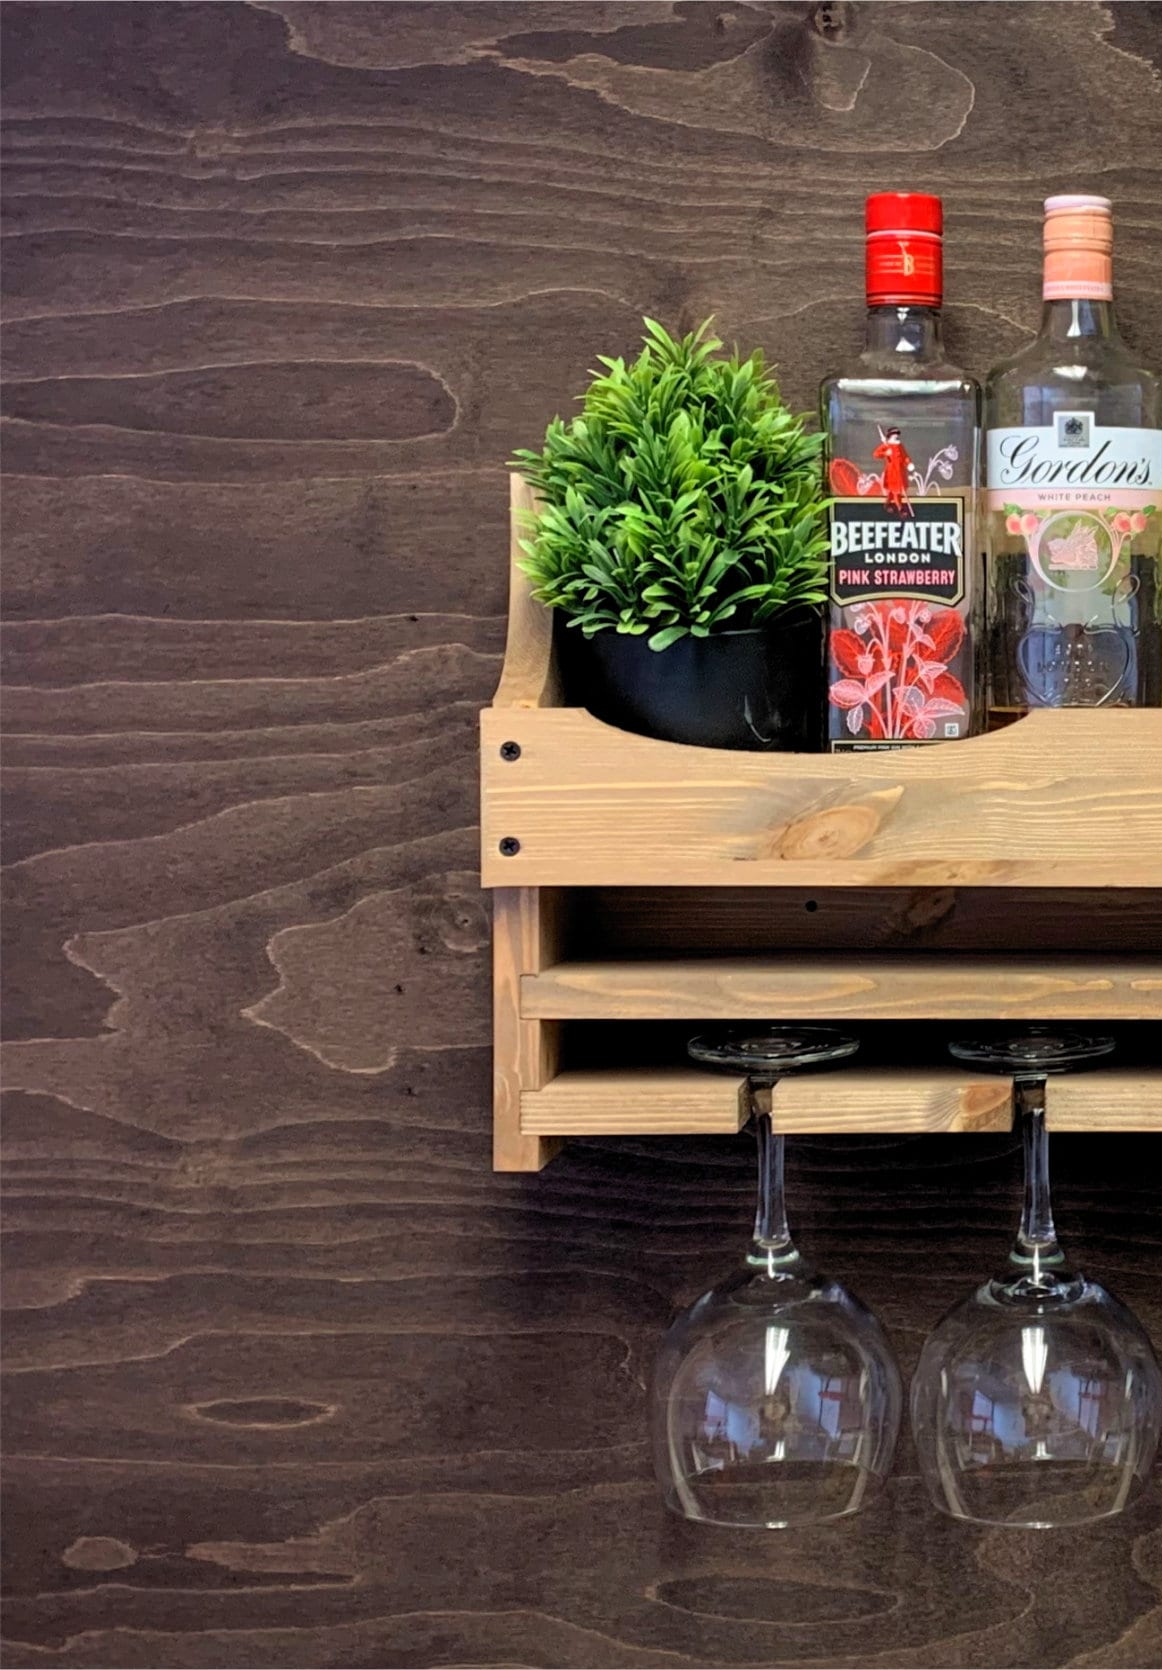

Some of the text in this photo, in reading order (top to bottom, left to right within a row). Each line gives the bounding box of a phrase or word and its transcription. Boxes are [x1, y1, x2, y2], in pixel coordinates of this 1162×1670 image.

[999, 435, 1151, 486] Gordon's
[1038, 493, 1111, 501] WHITE PEACH
[831, 521, 963, 557] BEEFEATER
[865, 553, 931, 564] LONDON
[839, 570, 955, 585] PINK STRAWBERRY
